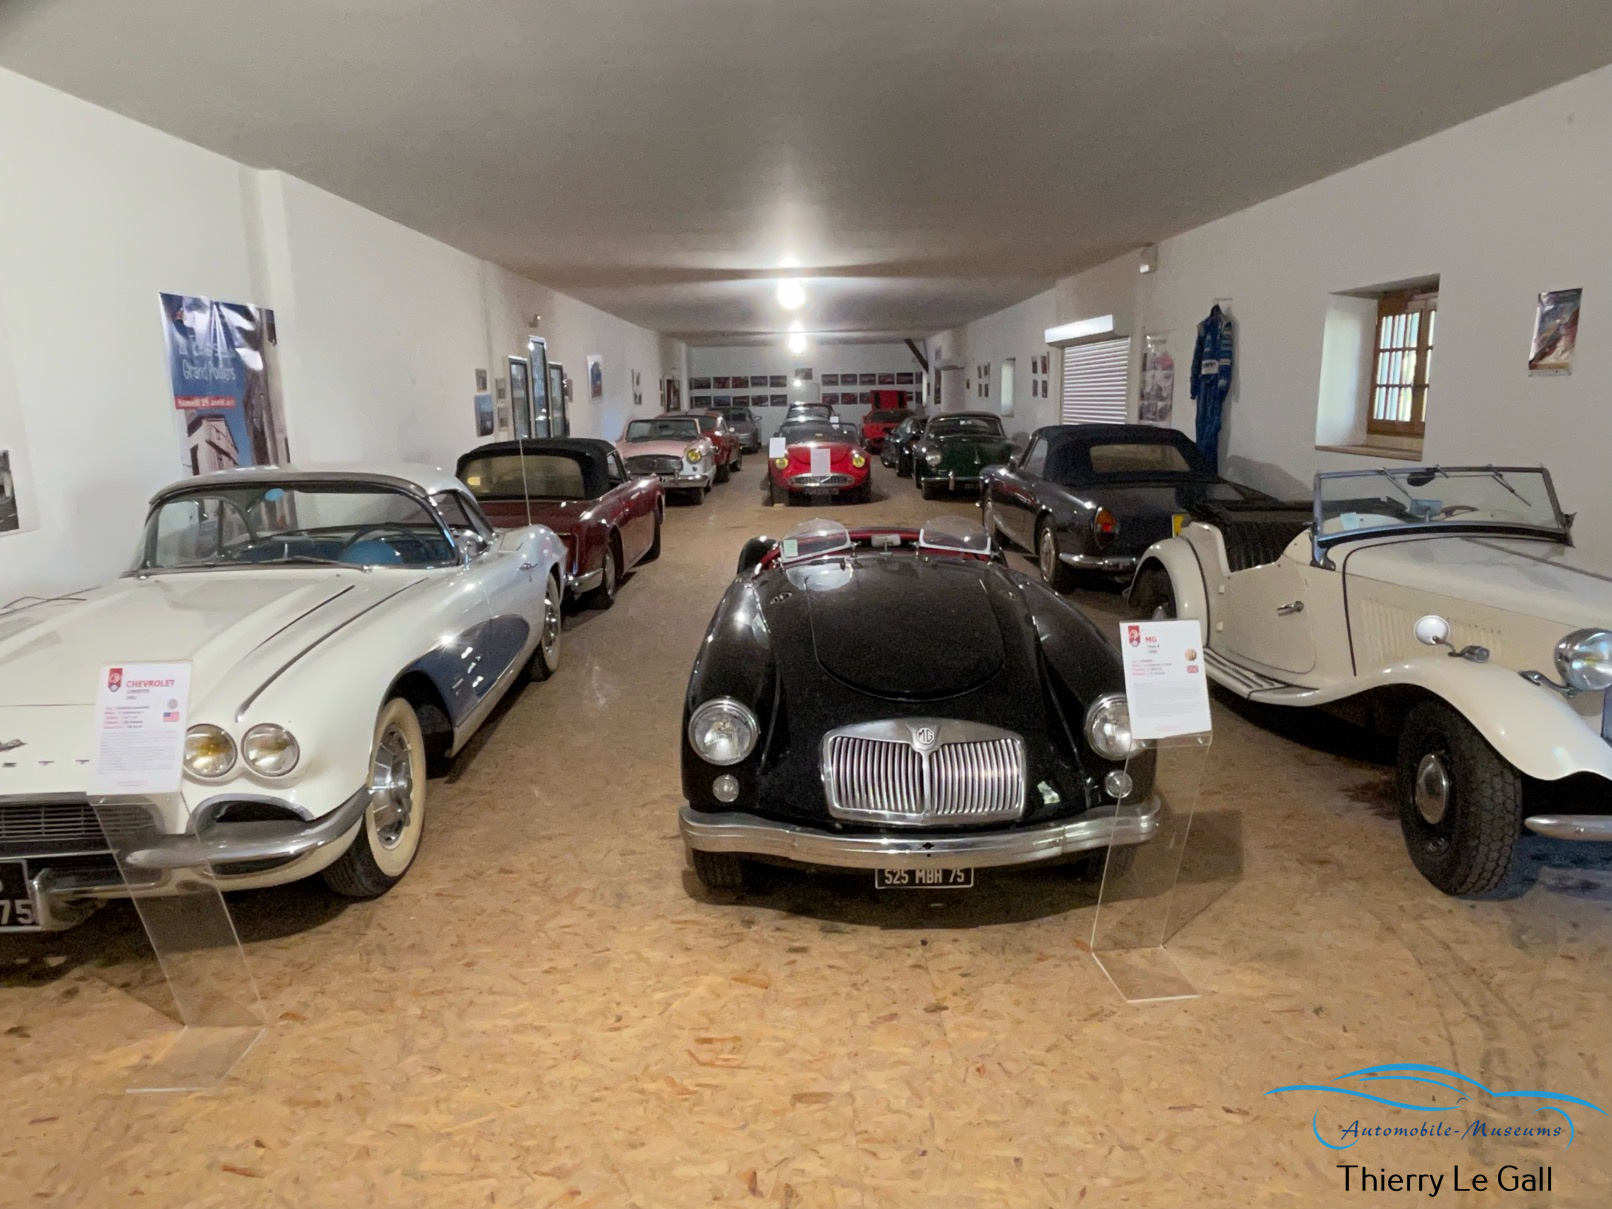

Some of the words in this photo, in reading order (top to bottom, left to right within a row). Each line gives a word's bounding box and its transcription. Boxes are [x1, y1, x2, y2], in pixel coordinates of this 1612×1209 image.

[126, 679, 175, 689] CHEVROLET
[917, 728, 935, 744] MG
[884, 868, 909, 884] 525
[949, 868, 965, 883] 75
